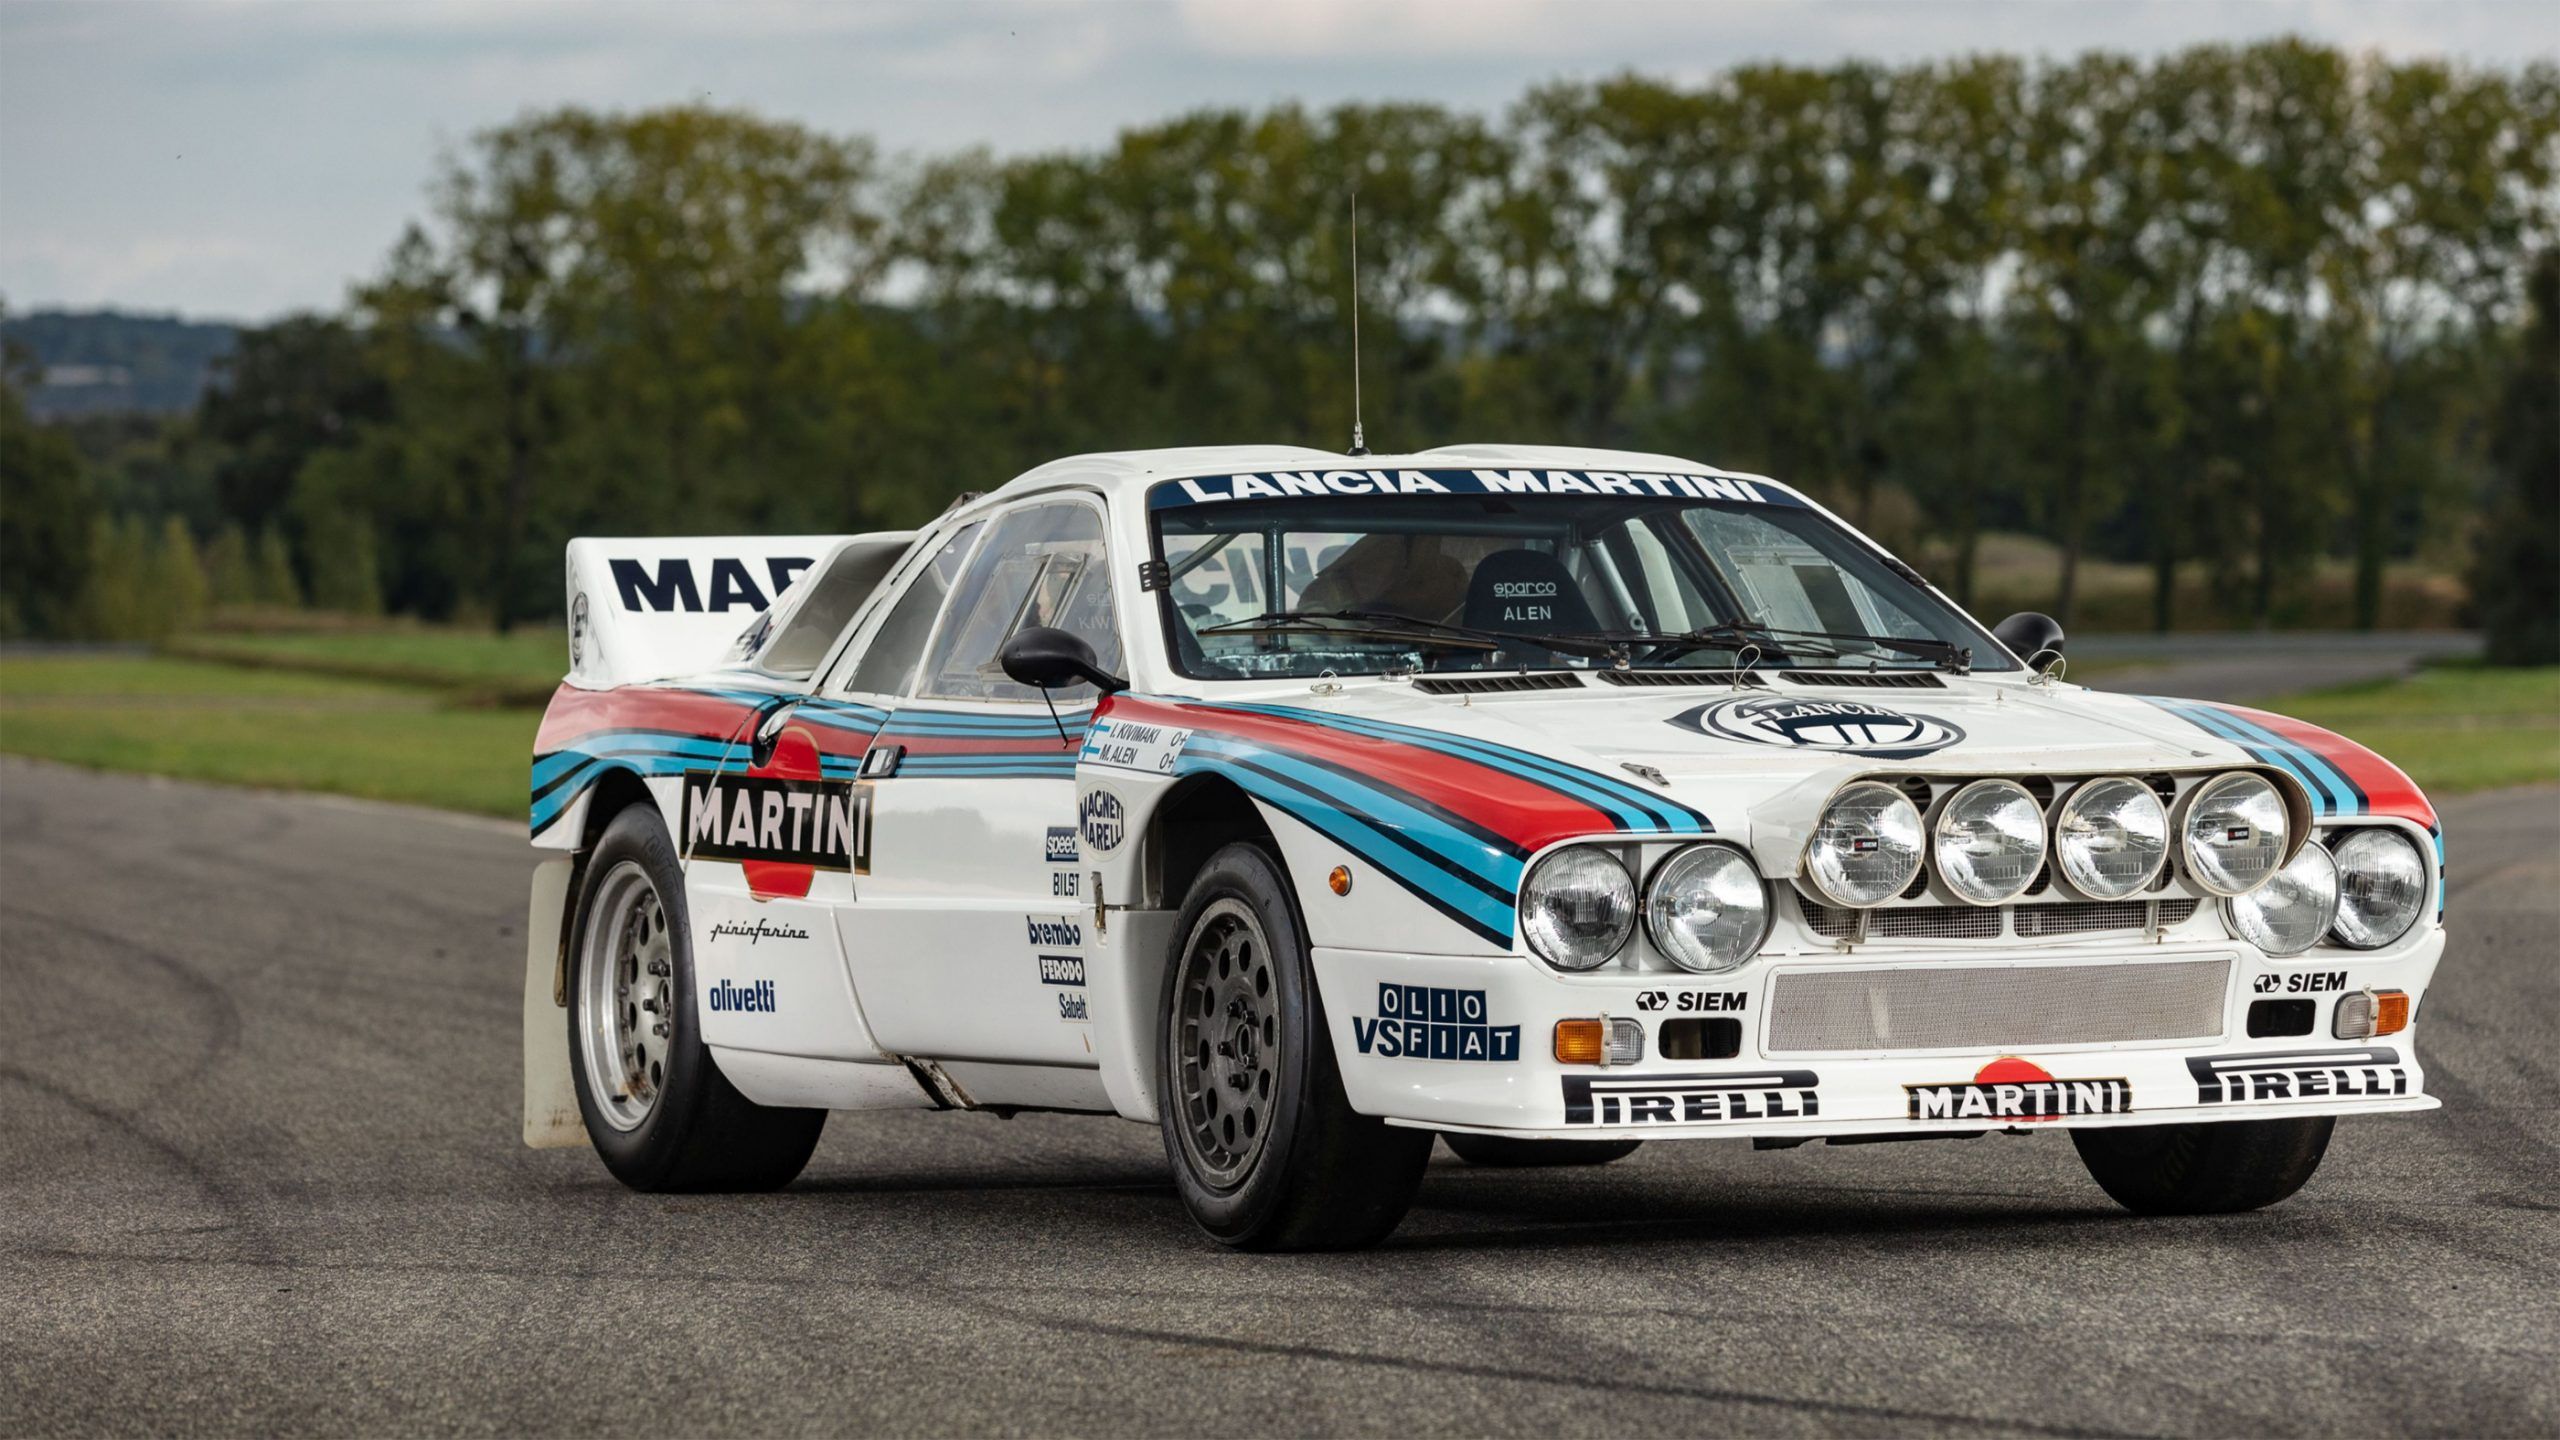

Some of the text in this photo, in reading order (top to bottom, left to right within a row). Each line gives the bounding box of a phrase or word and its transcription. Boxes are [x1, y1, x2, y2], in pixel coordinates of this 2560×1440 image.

[1177, 469, 1767, 503] LANCIA MARTINI
[1493, 581, 1557, 599] sparco
[1503, 605, 1552, 621] ALEN
[1766, 703, 1903, 720] LANCIA
[1116, 722, 1162, 744] KIVIMAKI
[1098, 743, 1112, 761] M.
[1110, 745, 1139, 765] ALEN
[1080, 790, 1124, 822] MAGNETI
[688, 785, 868, 857] MARTINI
[710, 918, 809, 945] pininfarina
[1026, 915, 1081, 946] brembo
[1040, 959, 1083, 982] FERODO
[2287, 971, 2348, 993] SIEM
[710, 979, 776, 1013] olivetti
[1059, 992, 1088, 1020] Sabelt
[1383, 988, 1482, 1019] OLIO
[1676, 991, 1748, 1011] SIEM
[2185, 1047, 2406, 1104] PIRELLI
[1561, 1069, 1819, 1125] PIRELLI
[1917, 1080, 2121, 1119] MARTINI
